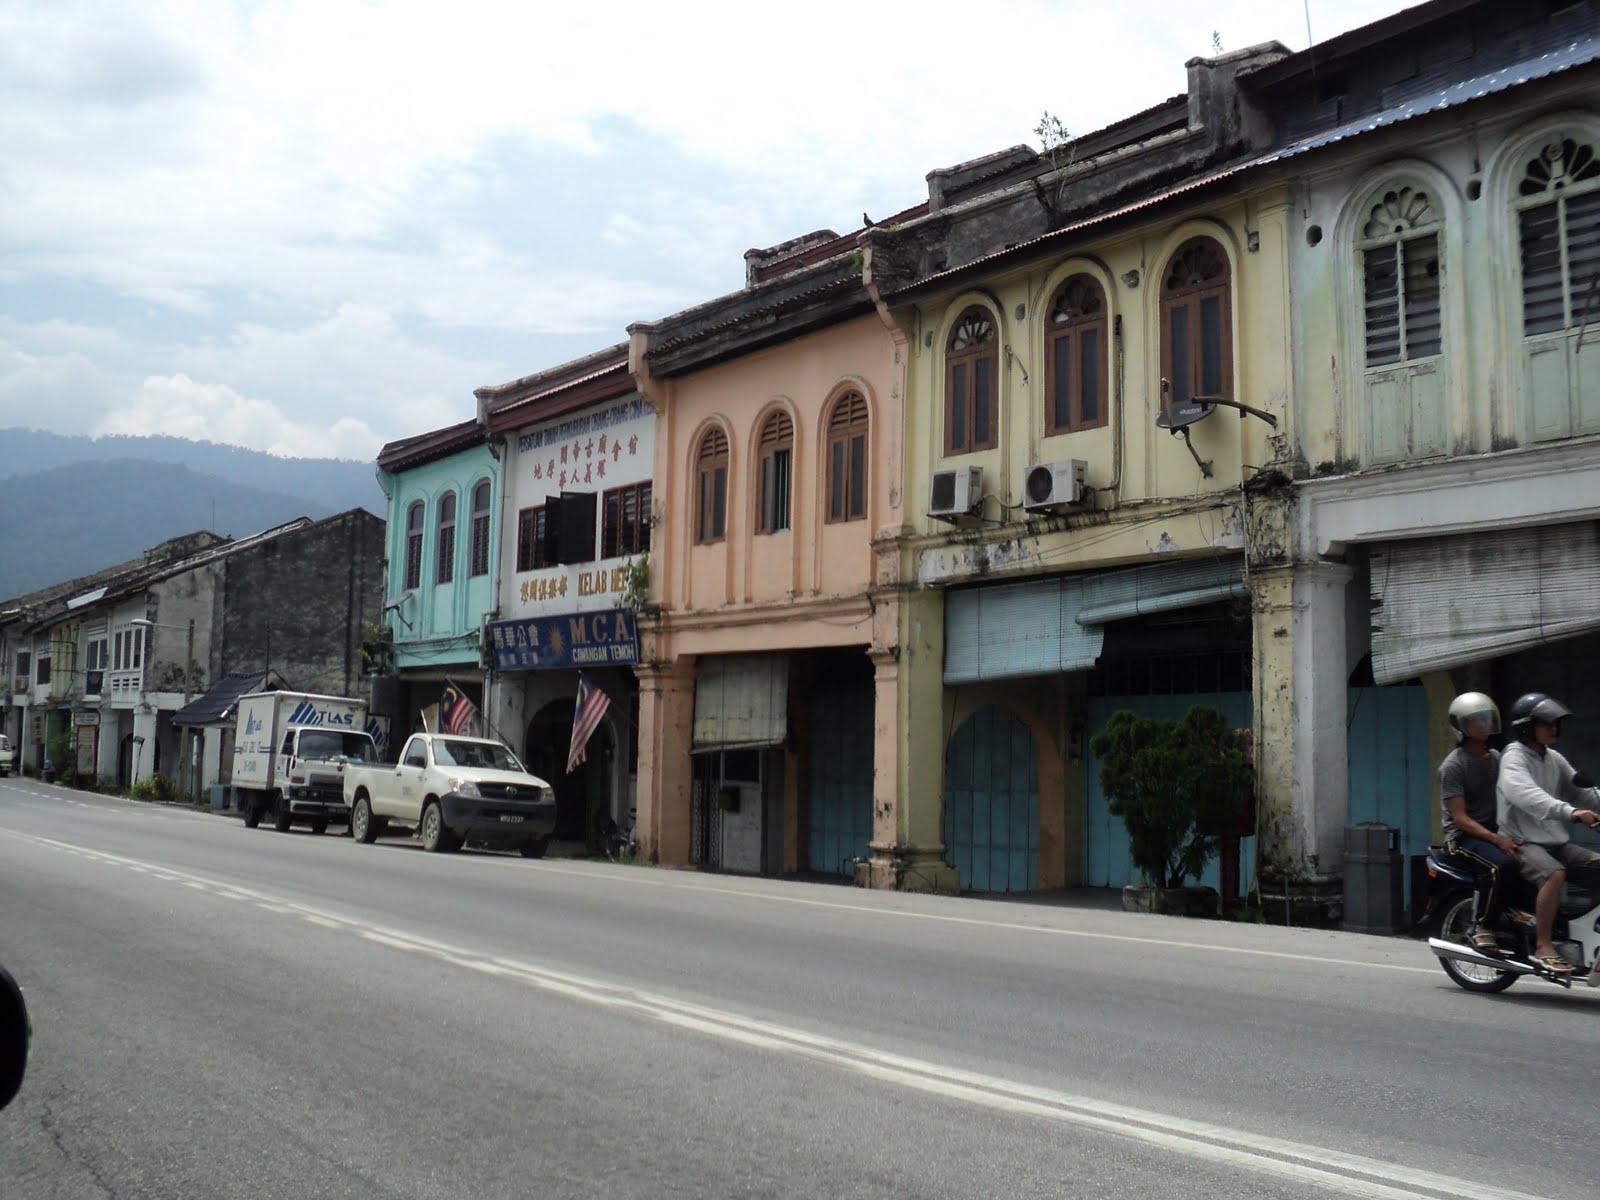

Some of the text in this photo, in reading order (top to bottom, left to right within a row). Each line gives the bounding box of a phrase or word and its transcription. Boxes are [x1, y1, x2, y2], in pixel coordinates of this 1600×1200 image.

[578, 569, 607, 597] KELAB
[572, 643, 635, 663] CAWANGAN TEMOH
